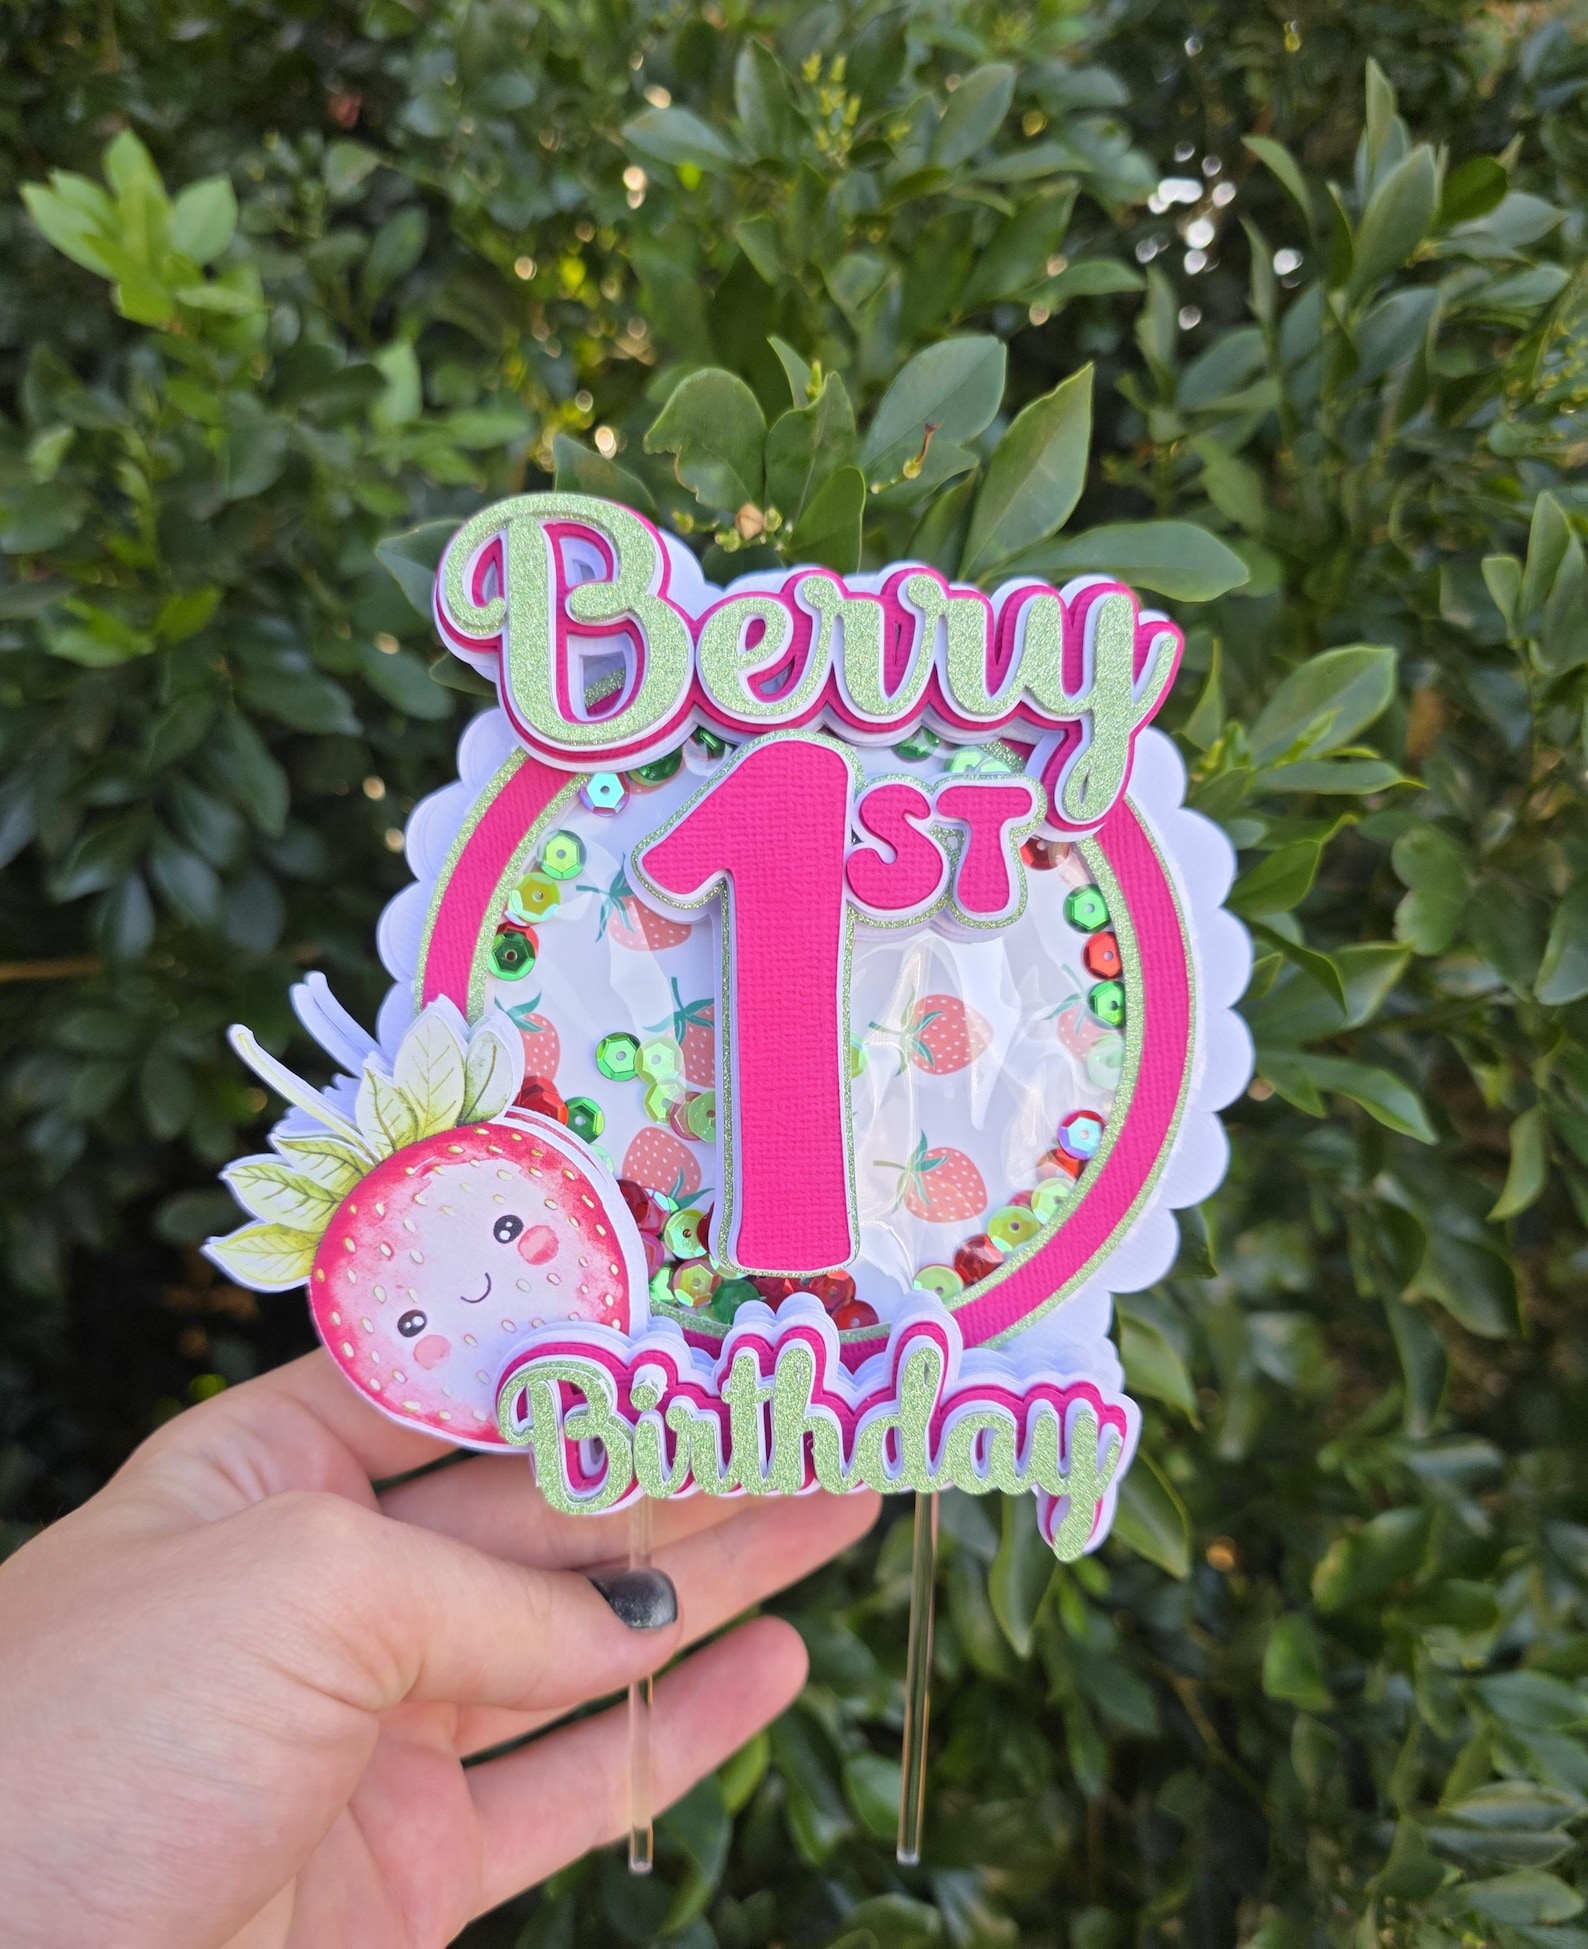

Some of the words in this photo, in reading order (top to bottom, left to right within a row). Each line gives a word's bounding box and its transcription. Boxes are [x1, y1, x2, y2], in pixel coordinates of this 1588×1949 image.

[440, 492, 1181, 823] Berry
[639, 737, 1033, 1272] 1ST
[498, 1346, 1122, 1563] Birthday
